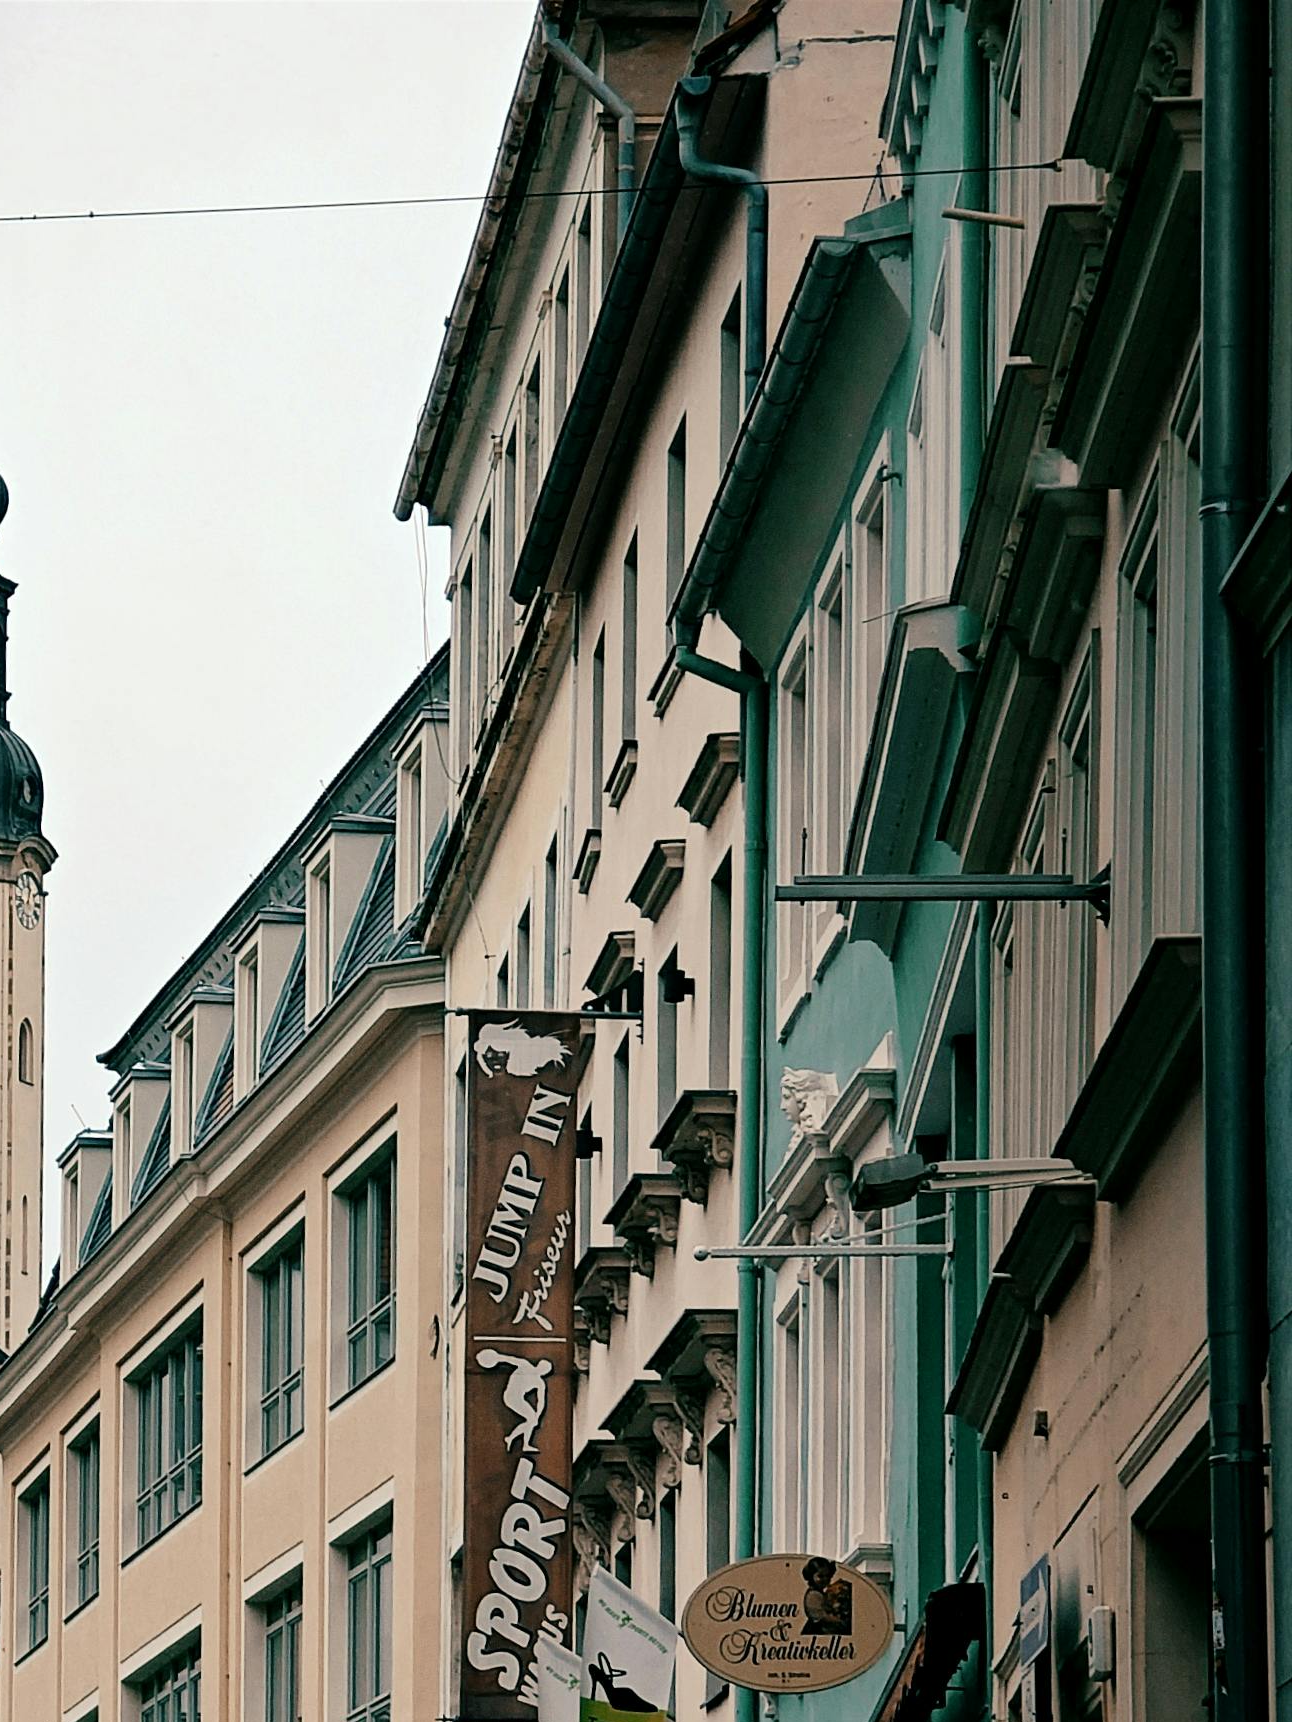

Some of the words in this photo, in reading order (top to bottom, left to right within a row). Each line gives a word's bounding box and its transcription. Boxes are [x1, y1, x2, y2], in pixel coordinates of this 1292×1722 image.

[472, 1152, 545, 1303] JUMP
[521, 1083, 572, 1147] IN
[512, 1209, 571, 1331] Friseur
[467, 1457, 570, 1691] SPORT
[705, 1585, 799, 1622] Blumen
[720, 1628, 856, 1665] Kreativkeller
[770, 1619, 792, 1642] &
